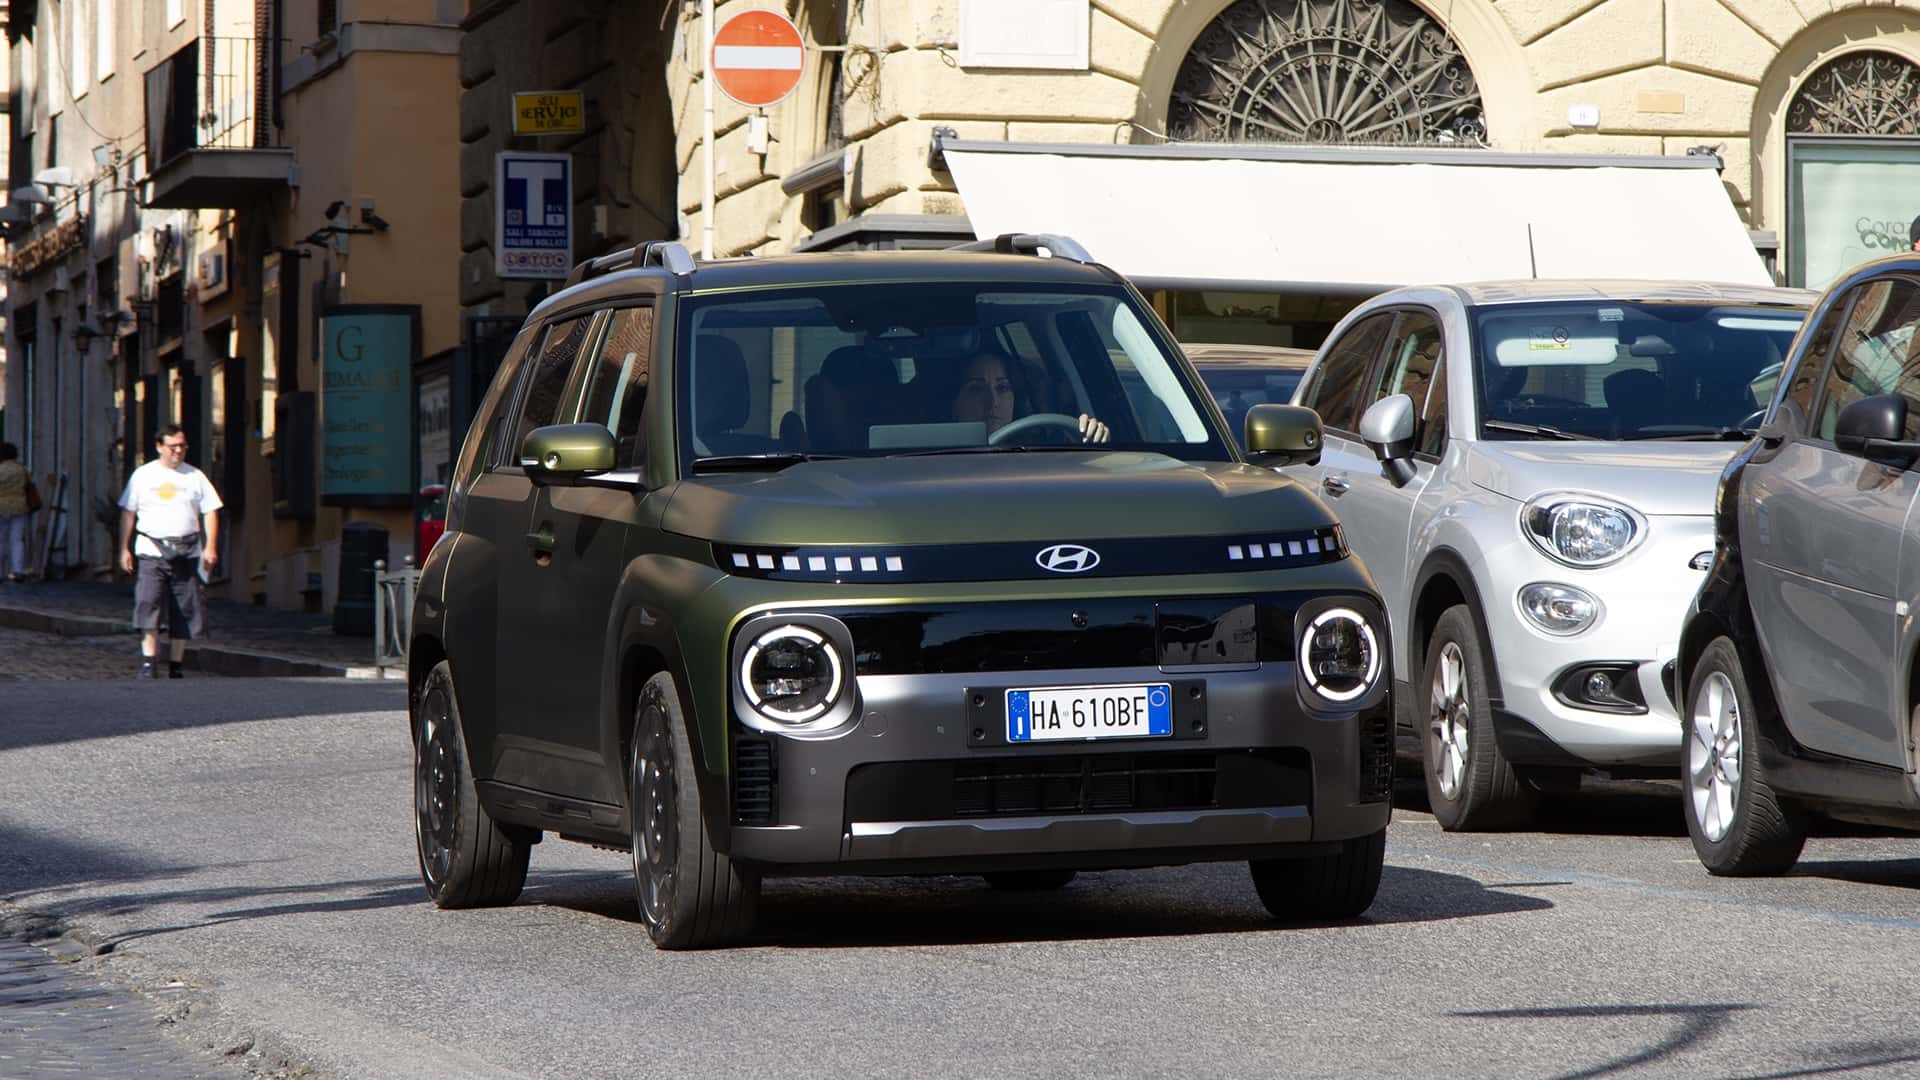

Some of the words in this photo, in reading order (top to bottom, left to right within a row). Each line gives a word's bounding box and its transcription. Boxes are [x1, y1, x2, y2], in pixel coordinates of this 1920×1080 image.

[507, 161, 563, 225] T
[1031, 700, 1061, 730] HA
[1072, 696, 1146, 728] 610BF
